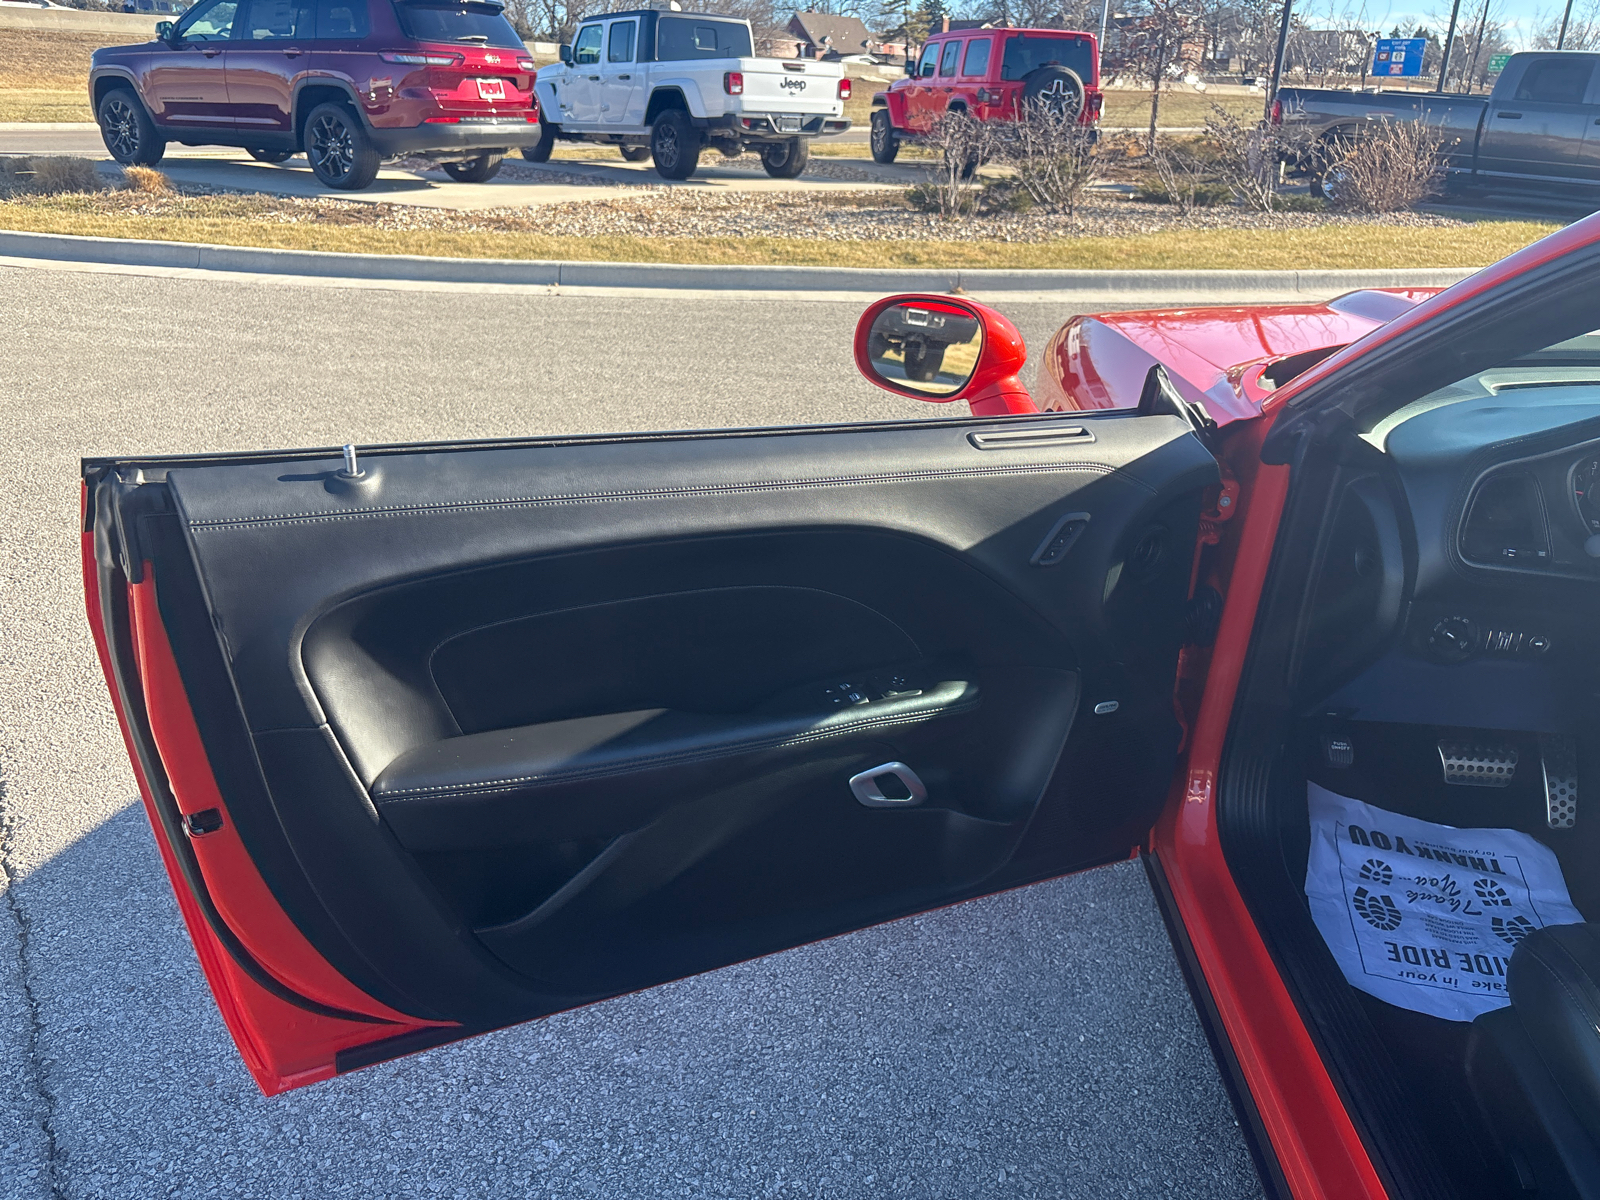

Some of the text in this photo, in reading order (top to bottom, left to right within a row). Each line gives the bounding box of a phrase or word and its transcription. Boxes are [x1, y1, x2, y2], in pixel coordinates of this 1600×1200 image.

[780, 76, 806, 91] Jeep
[1348, 824, 1507, 875] THANK YOU
[1414, 840, 1456, 853] business
[1406, 890, 1482, 915] Thank
[1384, 941, 1511, 977] IDE RIDE
[1397, 970, 1438, 983] your
[1443, 976, 1458, 988] in
